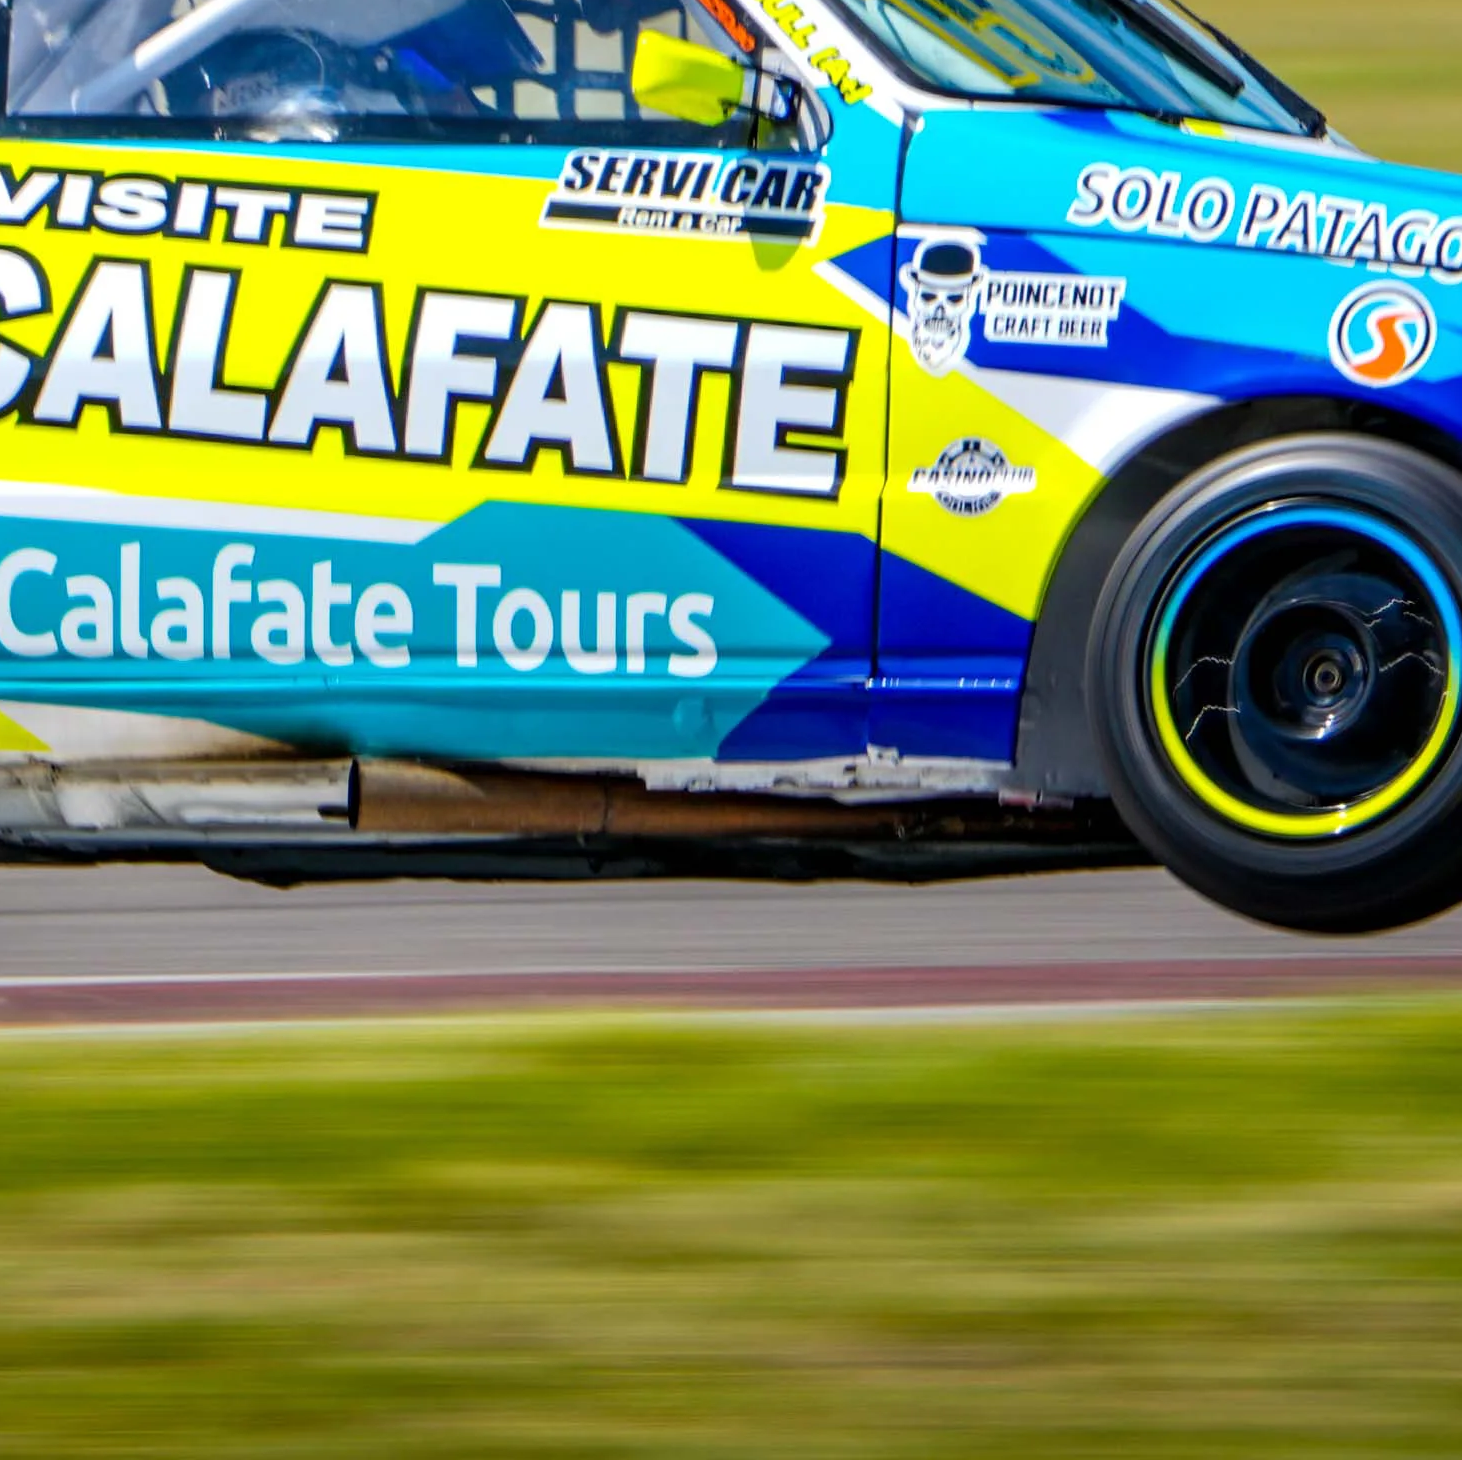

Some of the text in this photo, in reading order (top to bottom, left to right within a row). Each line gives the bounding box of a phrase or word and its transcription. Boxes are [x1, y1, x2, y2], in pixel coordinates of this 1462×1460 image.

[561, 152, 825, 213] SERVI CAR
[1071, 168, 1231, 238] SOLO
[986, 280, 1121, 310] POINCENOT
[992, 315, 1103, 340] CRAFT BEER
[433, 561, 719, 679] Tours
